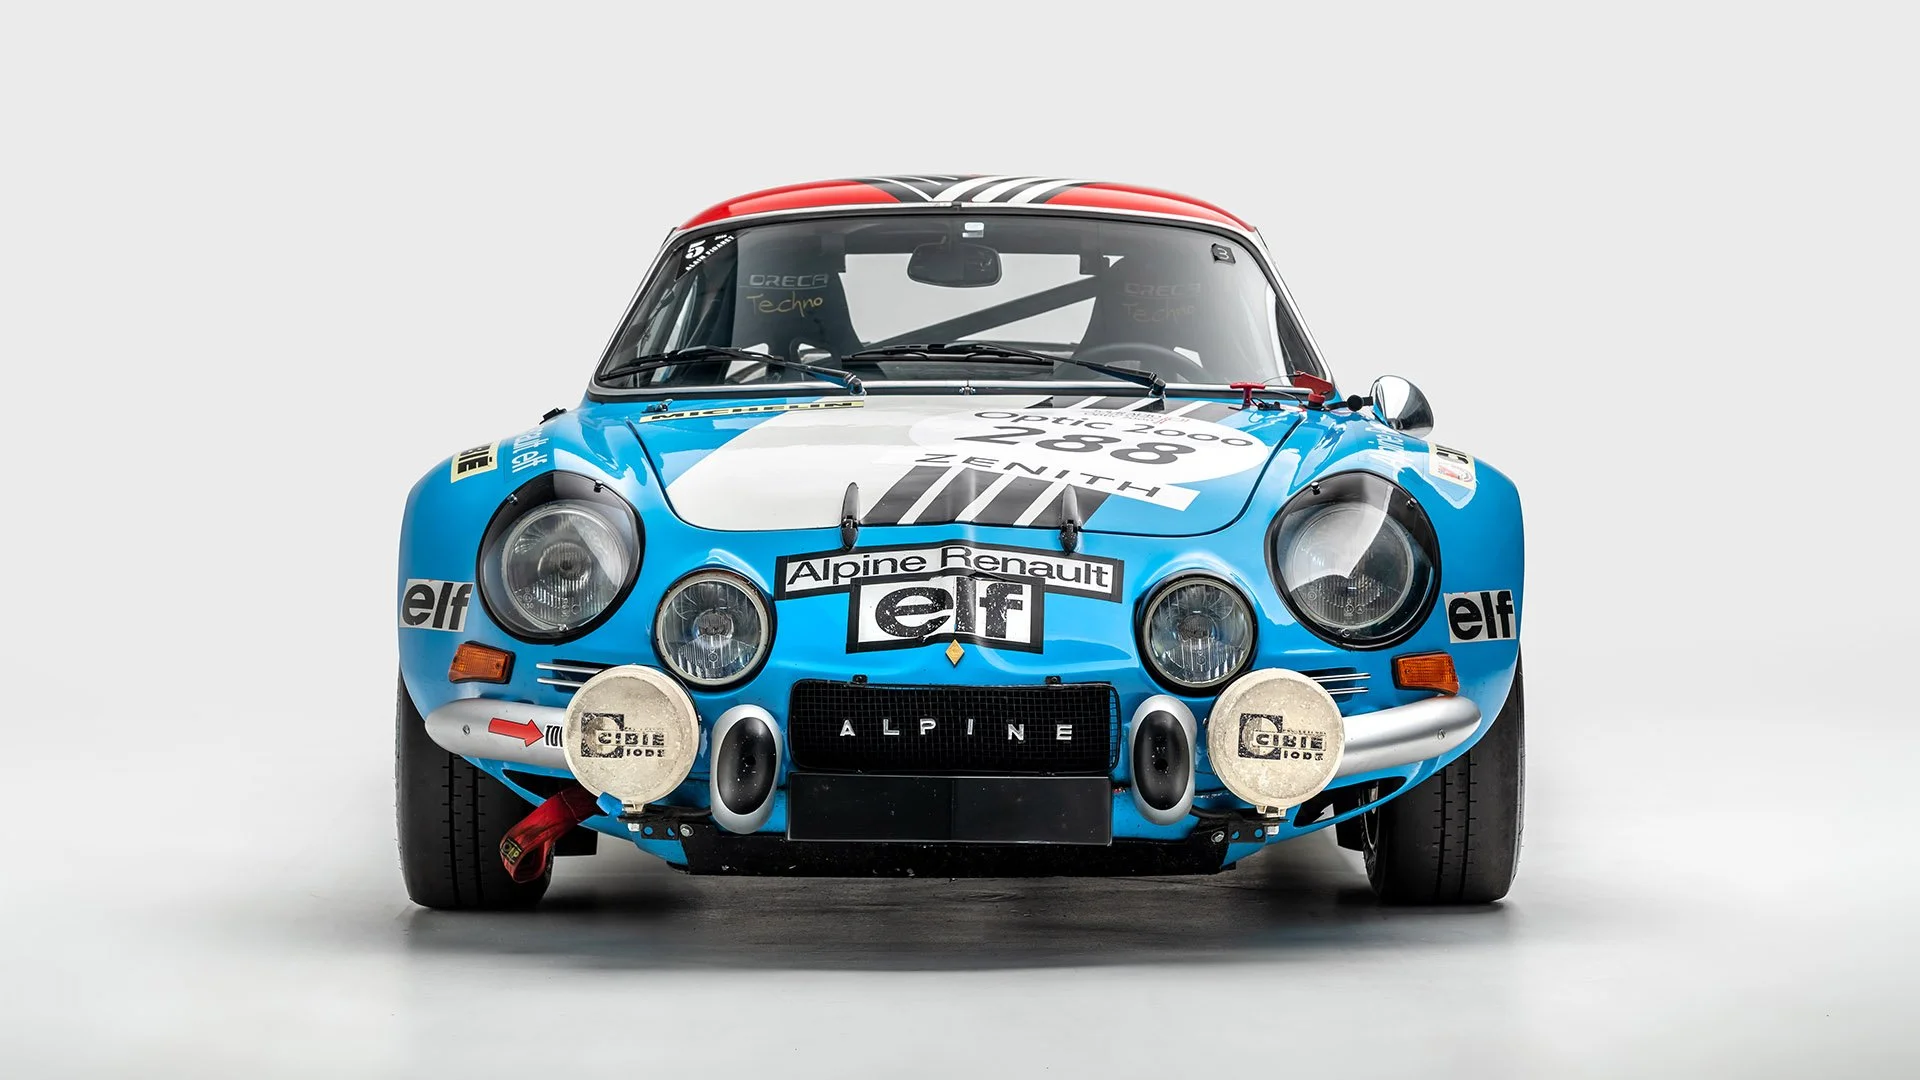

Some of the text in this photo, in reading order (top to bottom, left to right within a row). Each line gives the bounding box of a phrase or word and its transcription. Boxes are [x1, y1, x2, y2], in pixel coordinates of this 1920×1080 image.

[685, 239, 706, 259] 5
[749, 274, 829, 288] ORECA
[746, 290, 823, 318] Techno
[651, 401, 853, 420] MICHELIN
[974, 410, 1113, 431] Optic
[1122, 423, 1253, 447] 2000
[953, 426, 1196, 465] 288
[915, 453, 1161, 498] ZENITH
[787, 545, 1109, 588] Alpine Renault
[401, 582, 473, 631] elf
[875, 577, 1024, 640] elf
[1448, 591, 1514, 641] elf
[839, 717, 1074, 742] ALPINE
